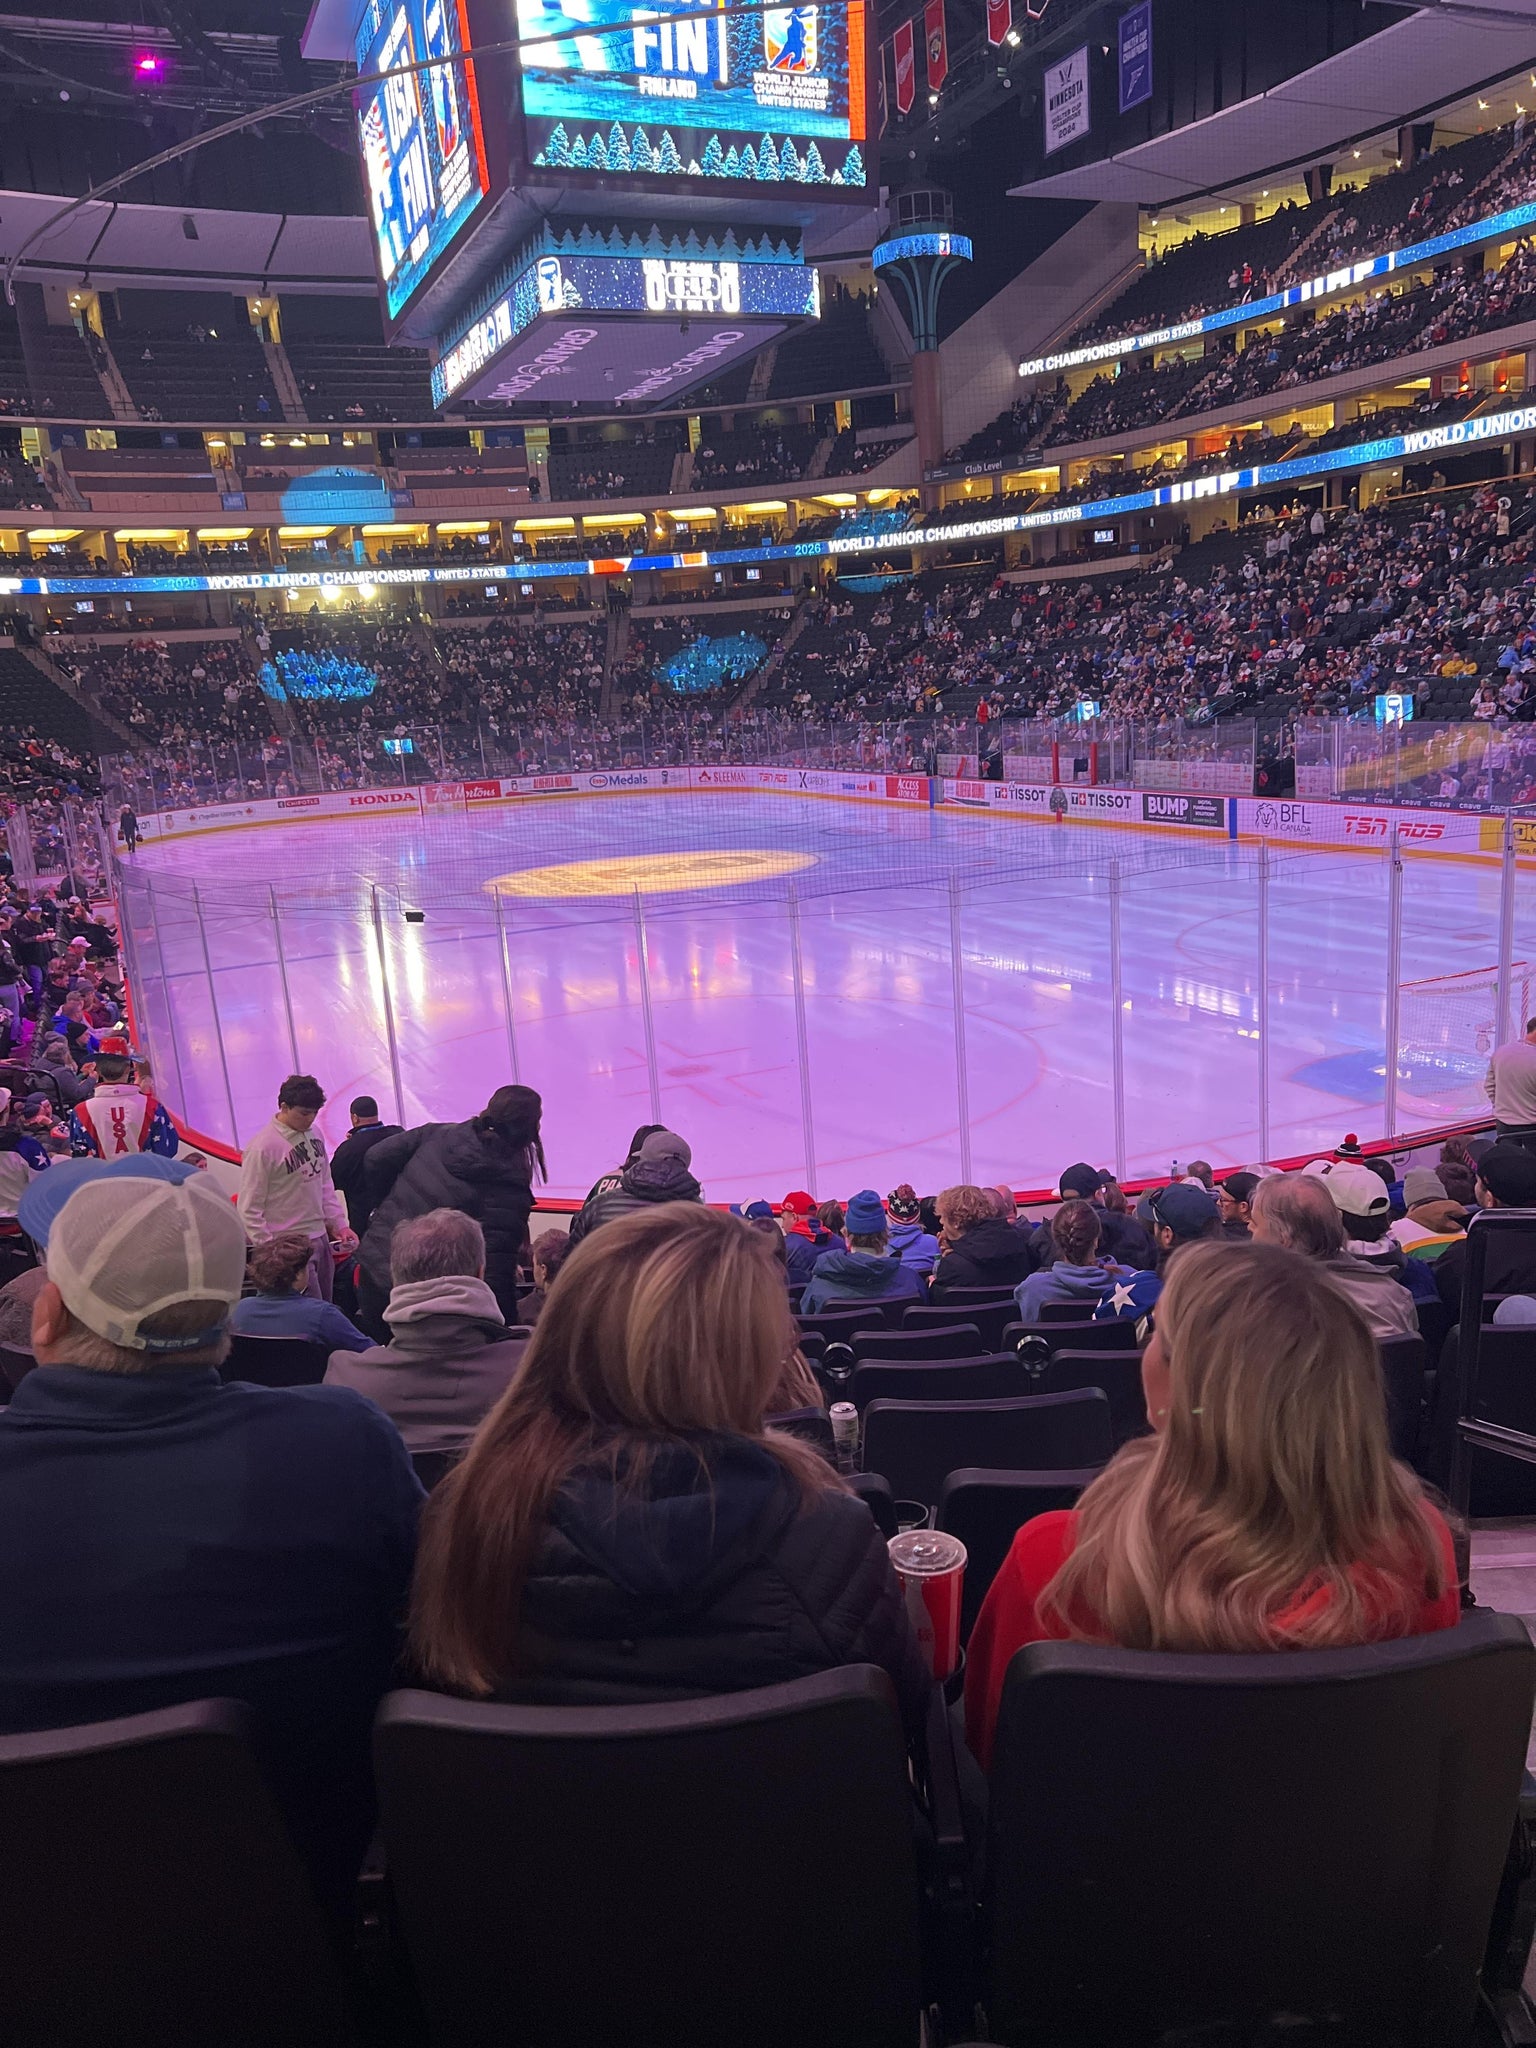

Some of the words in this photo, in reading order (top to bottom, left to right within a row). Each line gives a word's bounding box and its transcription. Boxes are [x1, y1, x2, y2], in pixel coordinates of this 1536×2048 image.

[632, 9, 709, 74] FIN
[639, 75, 697, 98] FINLAND
[753, 72, 790, 84] WORLD
[792, 76, 828, 89] JUNIOR
[384, 45, 418, 155] USA
[753, 83, 828, 99] CHAMPIONSHIP
[1049, 79, 1083, 111] MINNESOTA
[757, 95, 791, 107] UNITED
[793, 98, 826, 110] STATES
[398, 134, 428, 234] FIN
[534, 328, 599, 364] GRAND
[1046, 337, 1137, 371] CHAMPIONSHIP
[1138, 332, 1170, 348] UNITED
[1171, 320, 1203, 339] STATES
[487, 374, 541, 399] CASINO
[1404, 427, 1466, 454] WORLD
[1467, 407, 1536, 440] JUNIOR
[965, 464, 982, 475] Club
[984, 460, 1002, 472] Level
[795, 543, 822, 556] 2026
[828, 536, 875, 553] WORLD
[876, 529, 924, 547] JUNIOR
[925, 516, 1019, 542] CHAMPIONSHIP
[1021, 513, 1051, 527] UNITED
[1053, 506, 1083, 521] STATES
[206, 574, 262, 589] WORLD
[263, 572, 321, 586] JUNIOR
[322, 569, 431, 585] CHAMPIONSHIP
[433, 569, 469, 579] UNITED
[470, 567, 507, 578] STATES
[608, 773, 648, 787] Medals
[713, 771, 747, 783] SLEEMAN
[897, 779, 919, 790] ACCESS
[349, 792, 416, 806] HONDA
[897, 789, 919, 799] STORAGE
[1009, 786, 1046, 802] TISSOT
[1087, 793, 1132, 809] TISSOT
[1147, 796, 1189, 816] BUMP
[1281, 803, 1312, 824] BFL
[1280, 823, 1311, 832] CANADA
[1344, 815, 1388, 836] TSN
[110, 1107, 129, 1154] USA
[598, 1179, 622, 1194] PA
